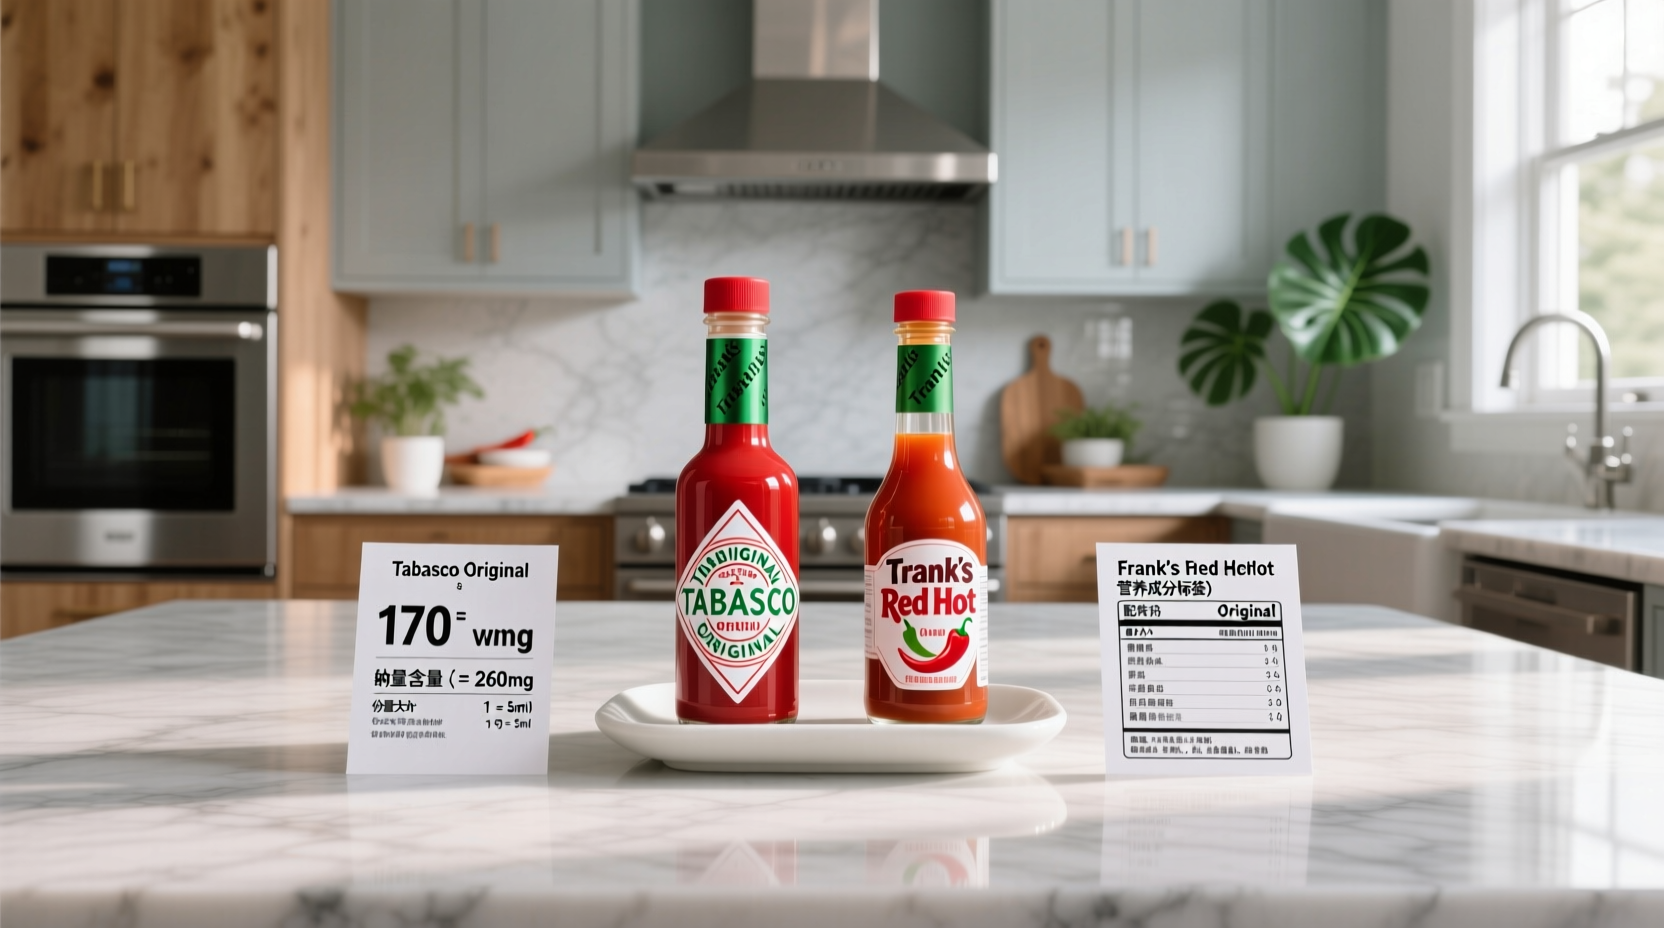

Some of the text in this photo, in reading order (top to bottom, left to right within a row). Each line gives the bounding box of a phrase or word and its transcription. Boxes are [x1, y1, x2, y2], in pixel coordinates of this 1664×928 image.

[392, 560, 529, 581] Tabasco Original
[886, 556, 974, 584] Trank's
[1117, 560, 1180, 576] Frank's
[681, 587, 796, 616] TABASCO
[881, 587, 929, 624] Red
[933, 587, 977, 616] Hot
[1217, 603, 1276, 621] Original
[378, 604, 451, 647] 170
[472, 628, 534, 654] wmg
[474, 670, 534, 692] 260mg
